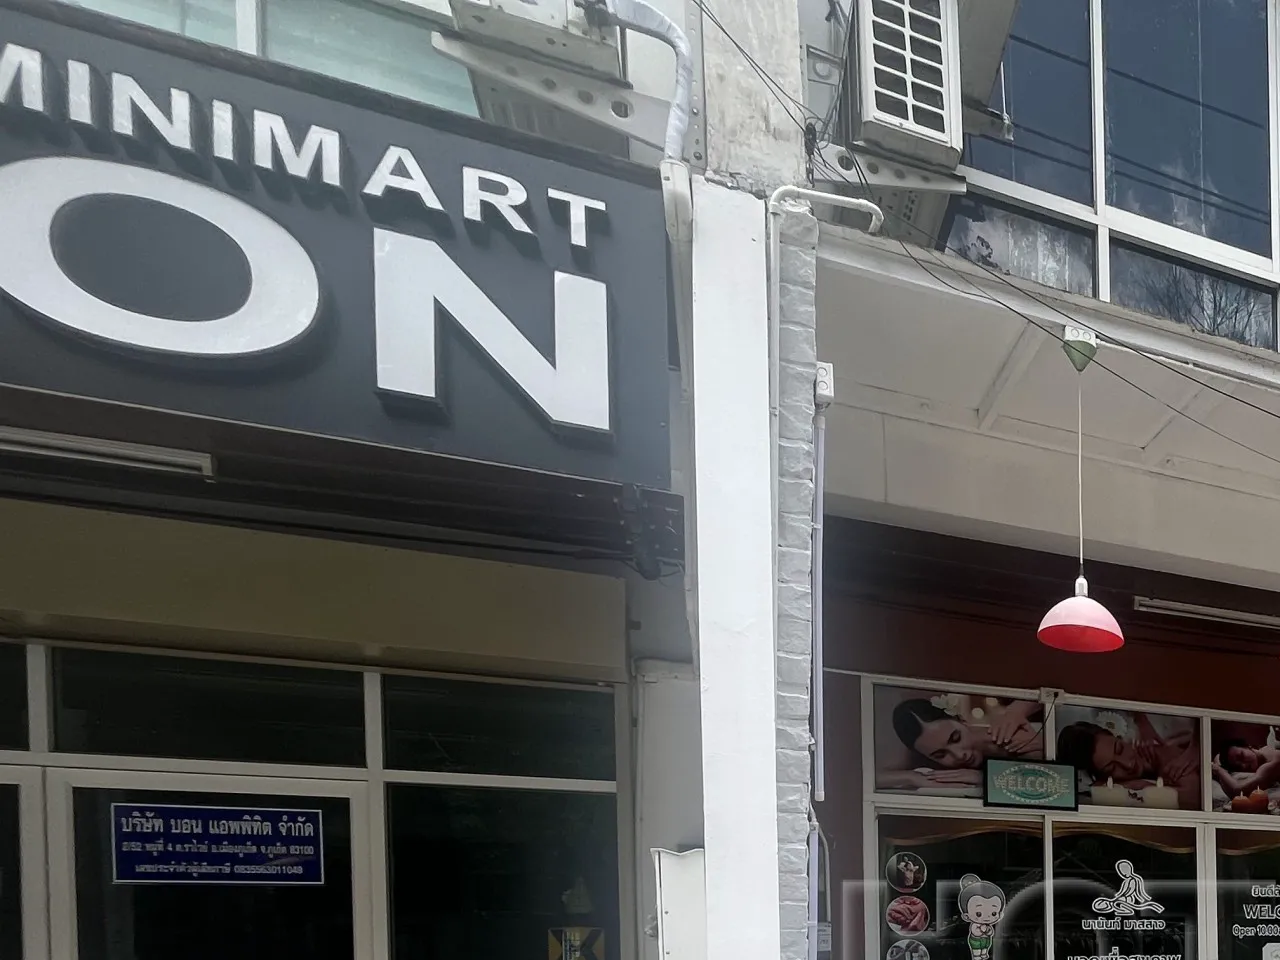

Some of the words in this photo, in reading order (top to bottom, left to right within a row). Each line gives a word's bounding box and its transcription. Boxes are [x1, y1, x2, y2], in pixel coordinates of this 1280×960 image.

[992, 774, 1070, 794] WELCOME
[121, 811, 164, 833] บริษัท
[170, 818, 203, 834] บอน
[278, 815, 314, 837] จำกัด
[1232, 924, 1257, 939] Open
